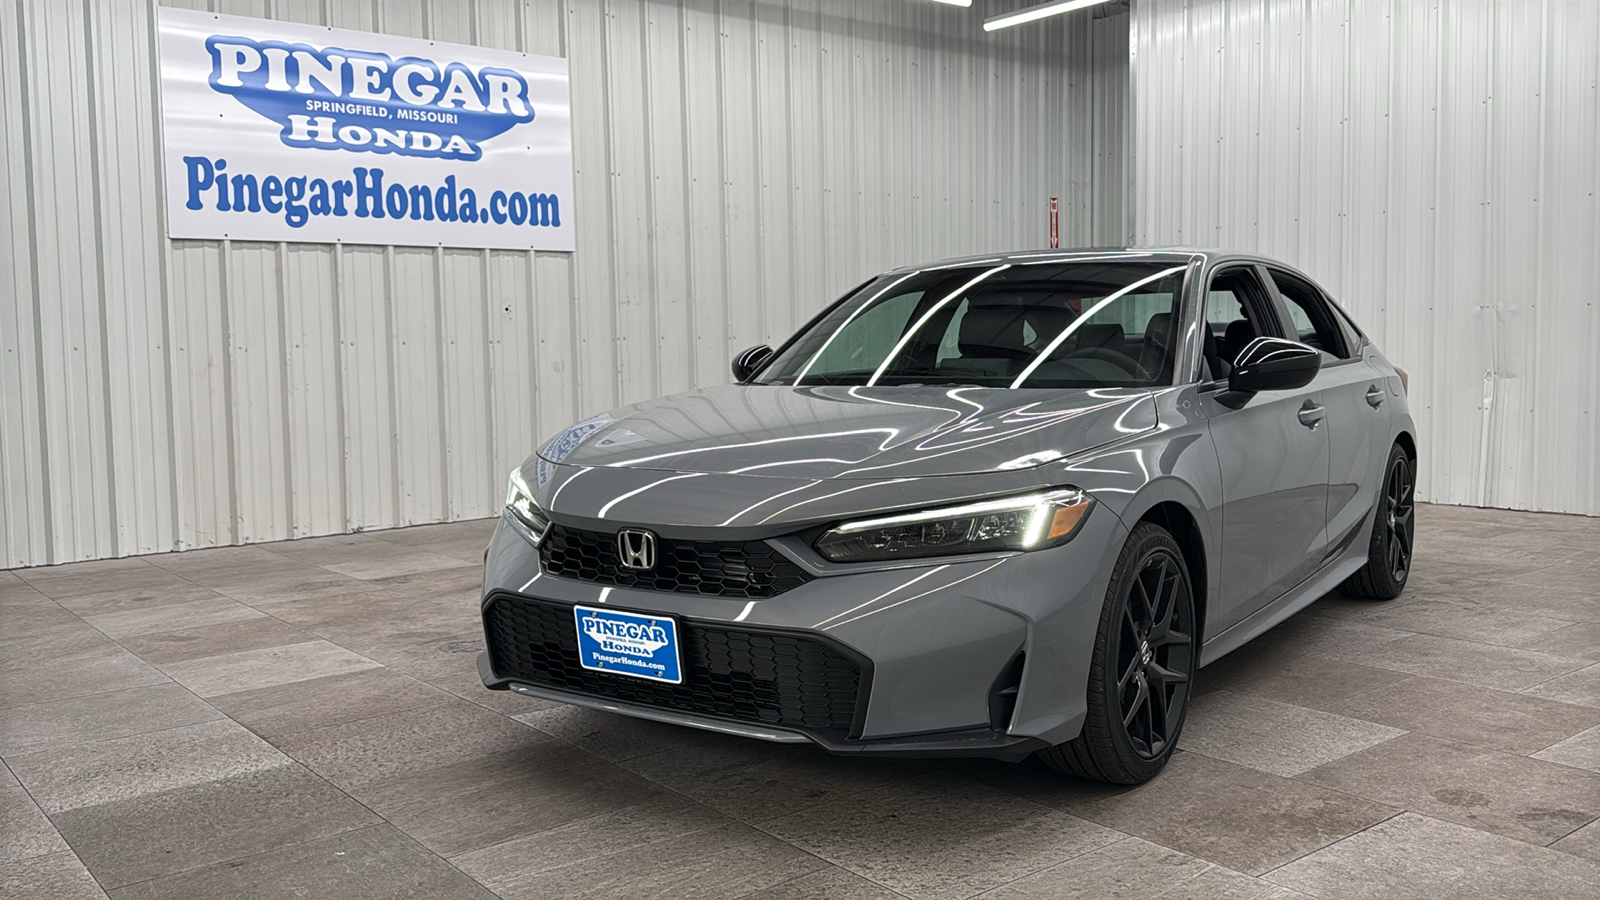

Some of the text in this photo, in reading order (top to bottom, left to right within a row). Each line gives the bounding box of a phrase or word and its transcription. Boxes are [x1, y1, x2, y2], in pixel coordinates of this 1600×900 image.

[214, 43, 530, 117] PINEGAR
[305, 100, 458, 125] SPRINGFIELD, MISSOURI
[288, 115, 476, 155] HONDA
[183, 156, 561, 229] PinegarHonda.com
[584, 619, 666, 643] PINEGAR
[602, 640, 652, 656] HONDA
[592, 652, 666, 671] PinegarHonda.com
